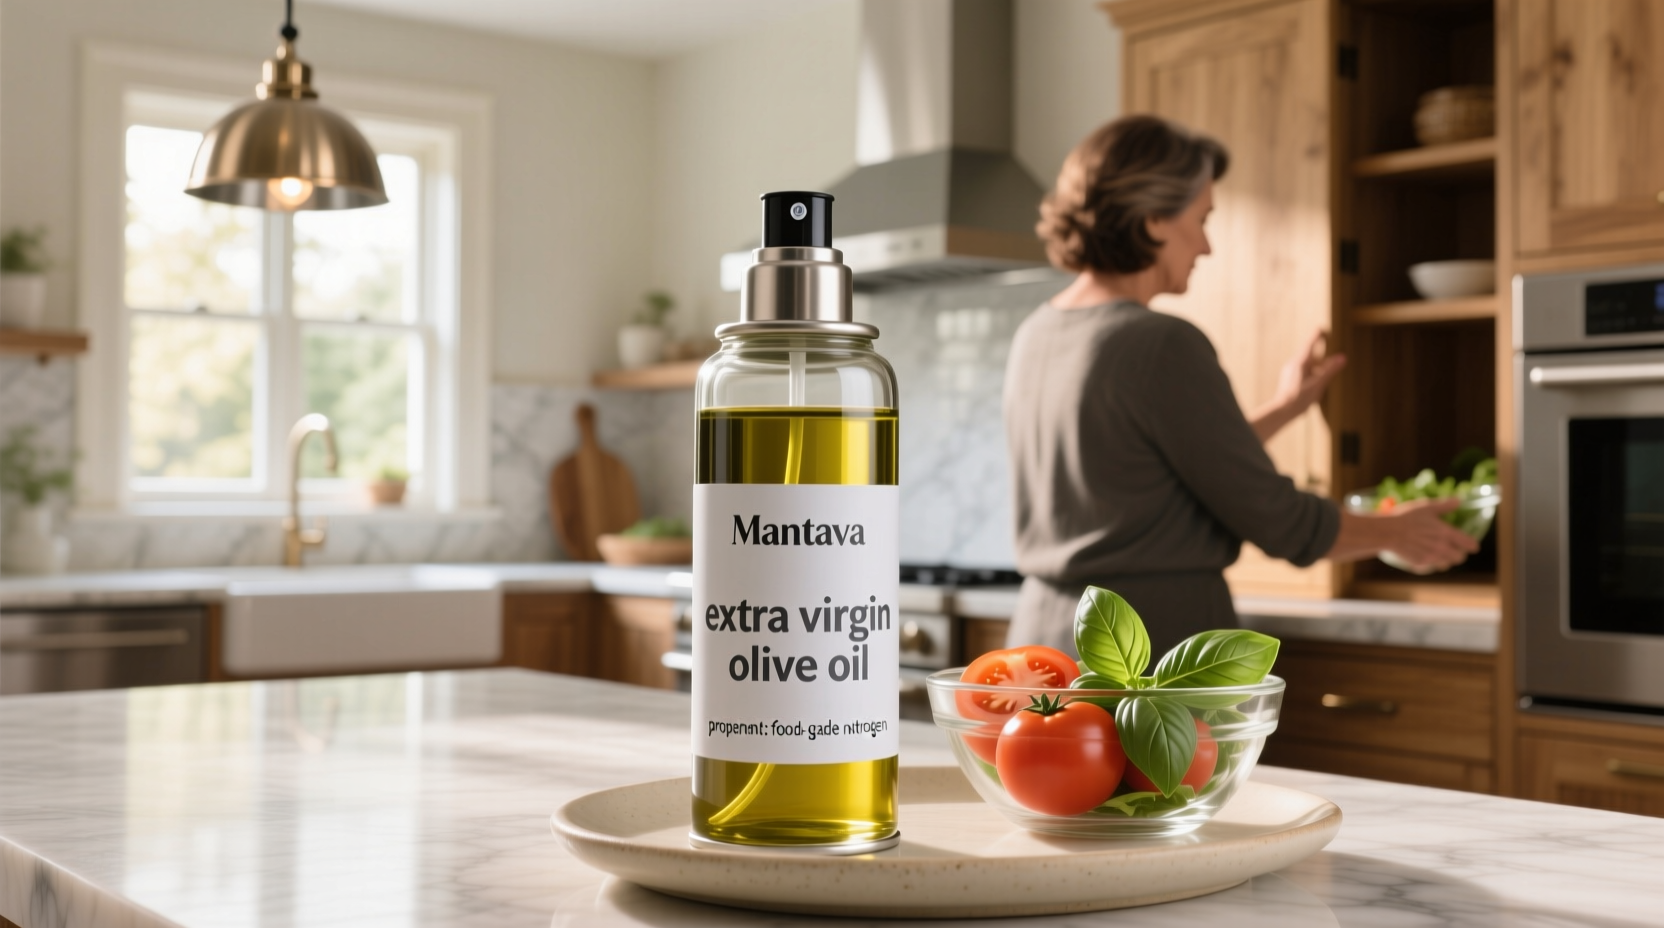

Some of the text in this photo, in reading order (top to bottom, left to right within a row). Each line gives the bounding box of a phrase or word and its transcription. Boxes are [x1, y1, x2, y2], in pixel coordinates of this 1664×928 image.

[731, 514, 866, 546] Mantava
[705, 595, 891, 642] extra virgin
[728, 643, 869, 682] olive oil
